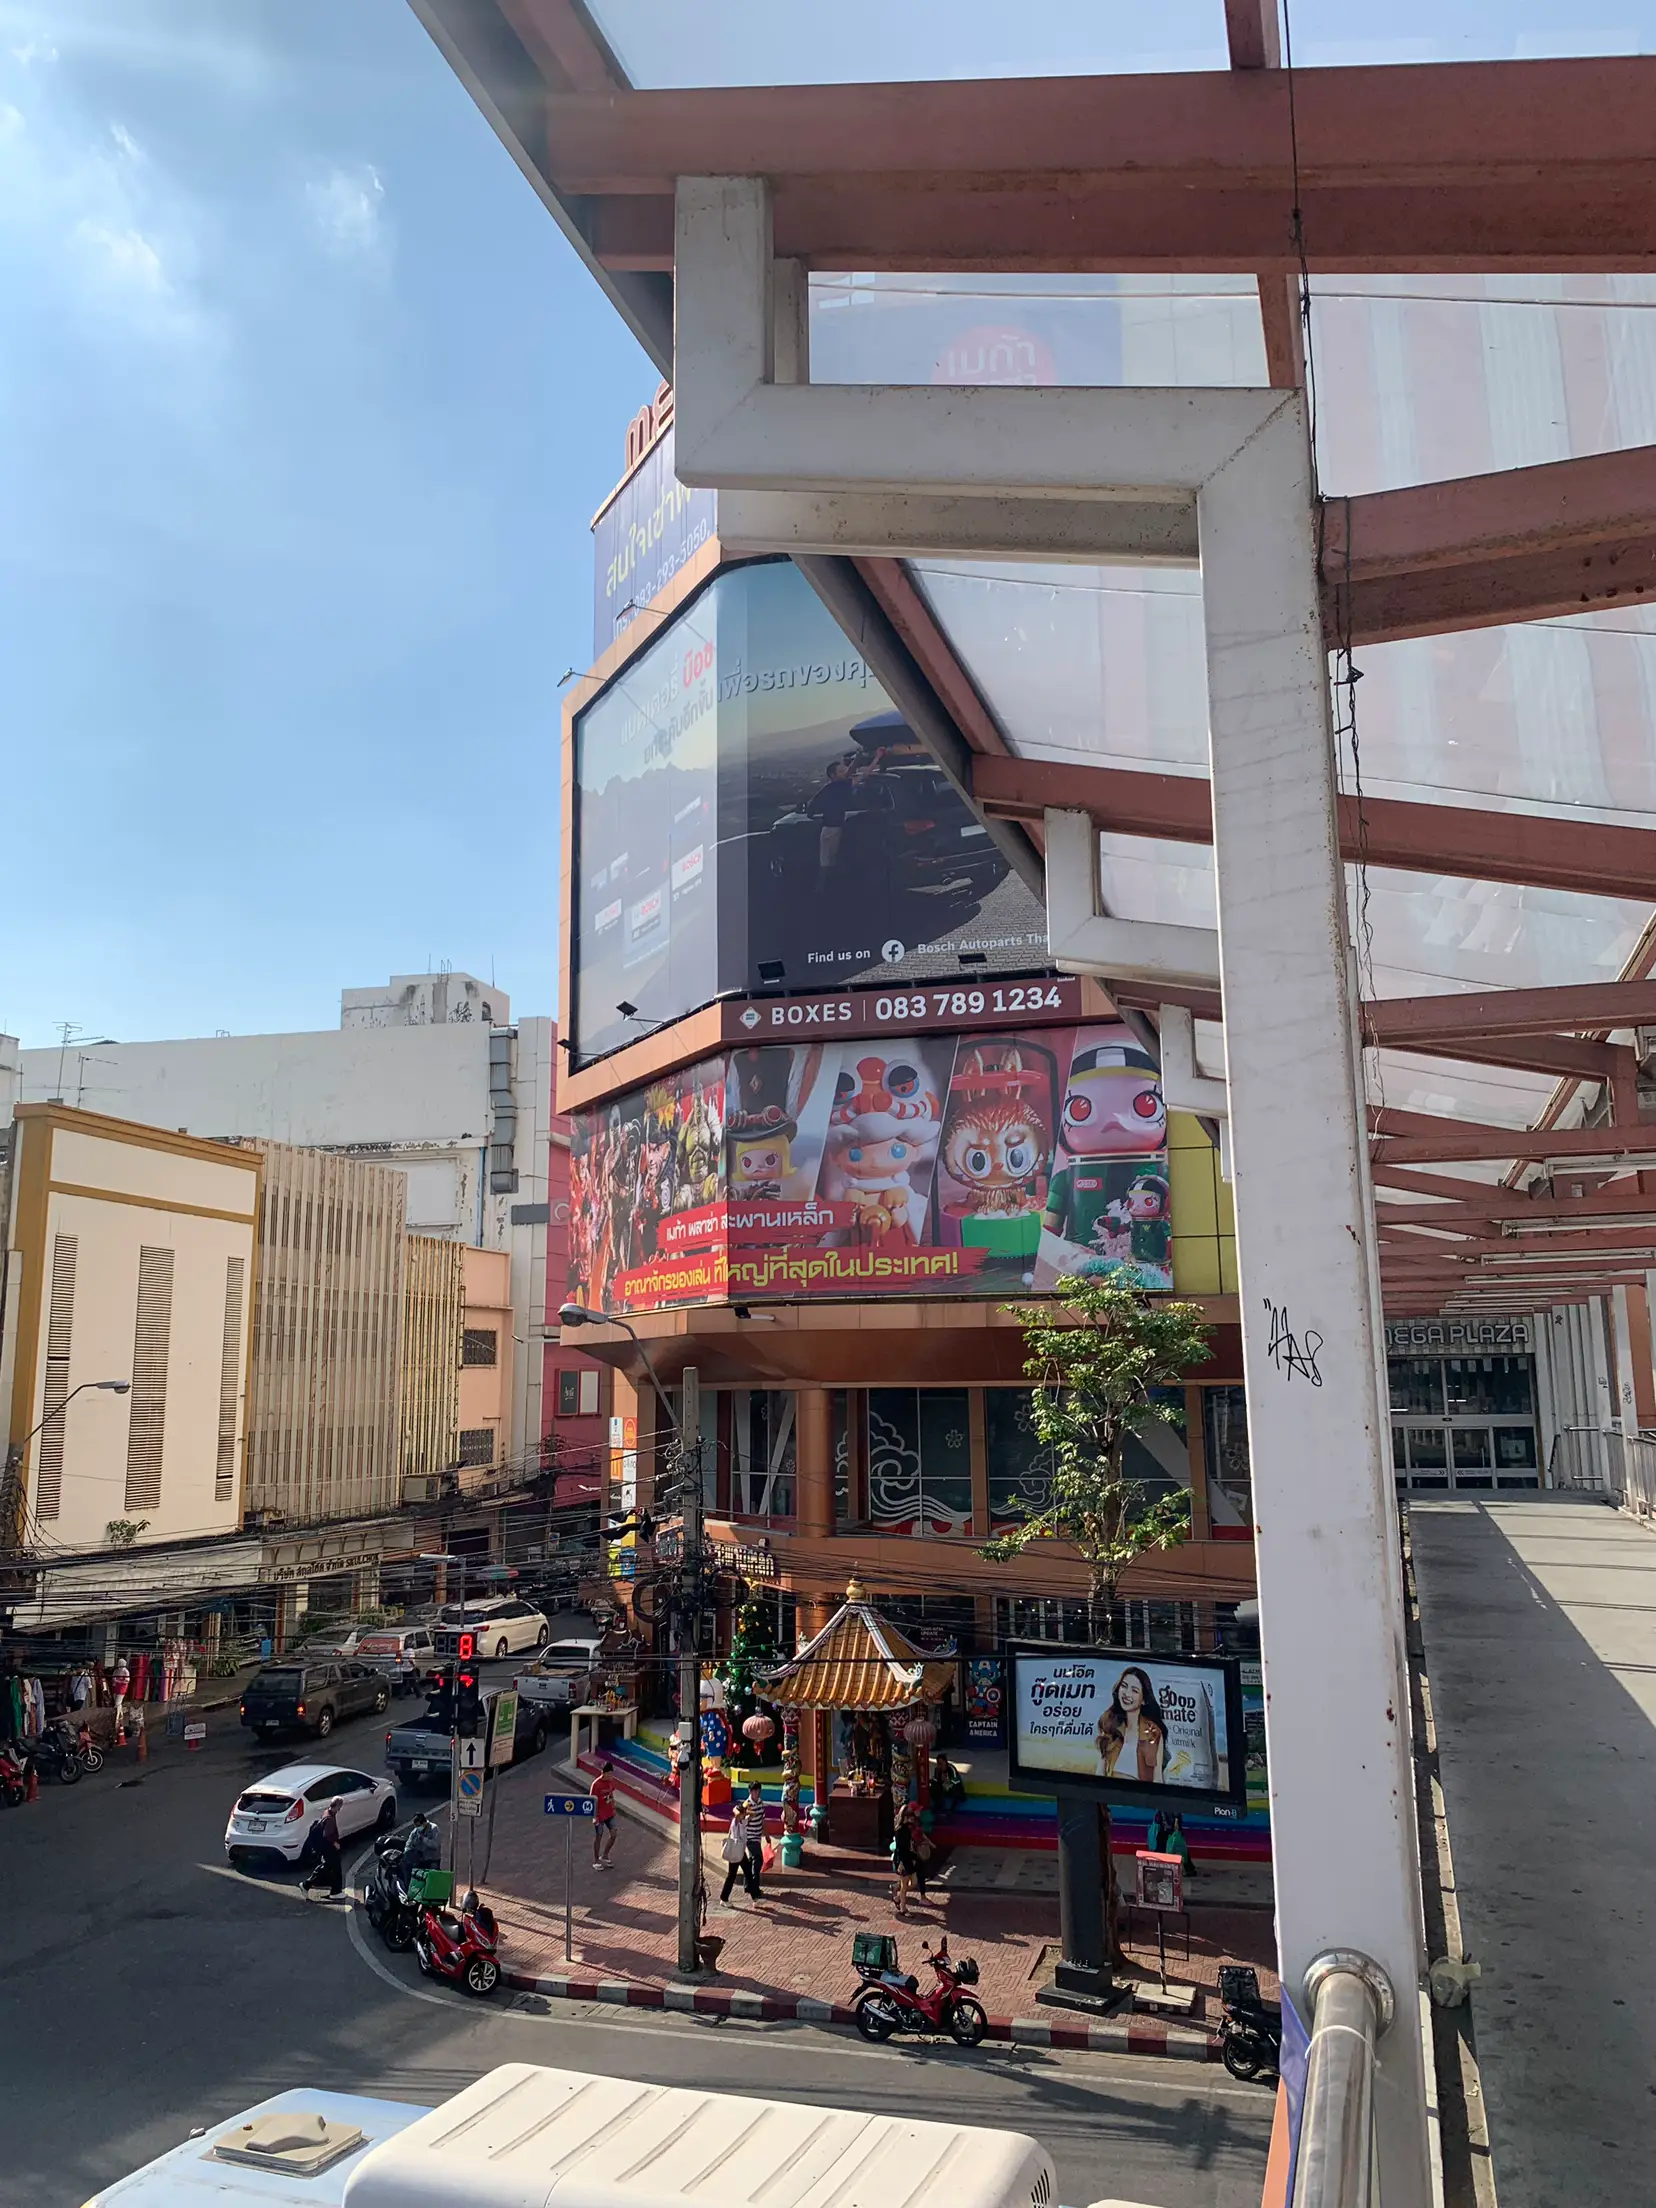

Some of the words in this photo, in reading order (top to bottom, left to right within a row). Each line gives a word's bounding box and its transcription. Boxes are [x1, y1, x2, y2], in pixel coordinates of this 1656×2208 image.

[717, 656, 876, 703] เพื่อรถของคุ
[807, 952, 834, 964] Find
[836, 953, 853, 963] us
[856, 949, 871, 960] on
[918, 941, 955, 955] Bosch
[959, 936, 1023, 954] Autoparts
[771, 1002, 853, 1025] BOXES
[875, 995, 927, 1020] 083
[932, 990, 985, 1016] 789
[992, 985, 1063, 1013] 1234
[666, 1219, 687, 1241] เมก้า
[688, 1210, 718, 1238] พลาซ่า
[719, 1201, 835, 1232] สะพานเหล็ก
[624, 1260, 711, 1297] อาณาจักรของเล่น
[713, 1246, 959, 1288] ที่ใหญ่ที่สุดในประเทศ!
[1450, 1323, 1530, 1344] PLAZA
[1042, 1701, 1082, 1717] อร่อย
[1161, 1708, 1197, 1723] mate
[968, 1720, 998, 1728] CAPTAIN
[968, 1729, 998, 1737] AMERICA
